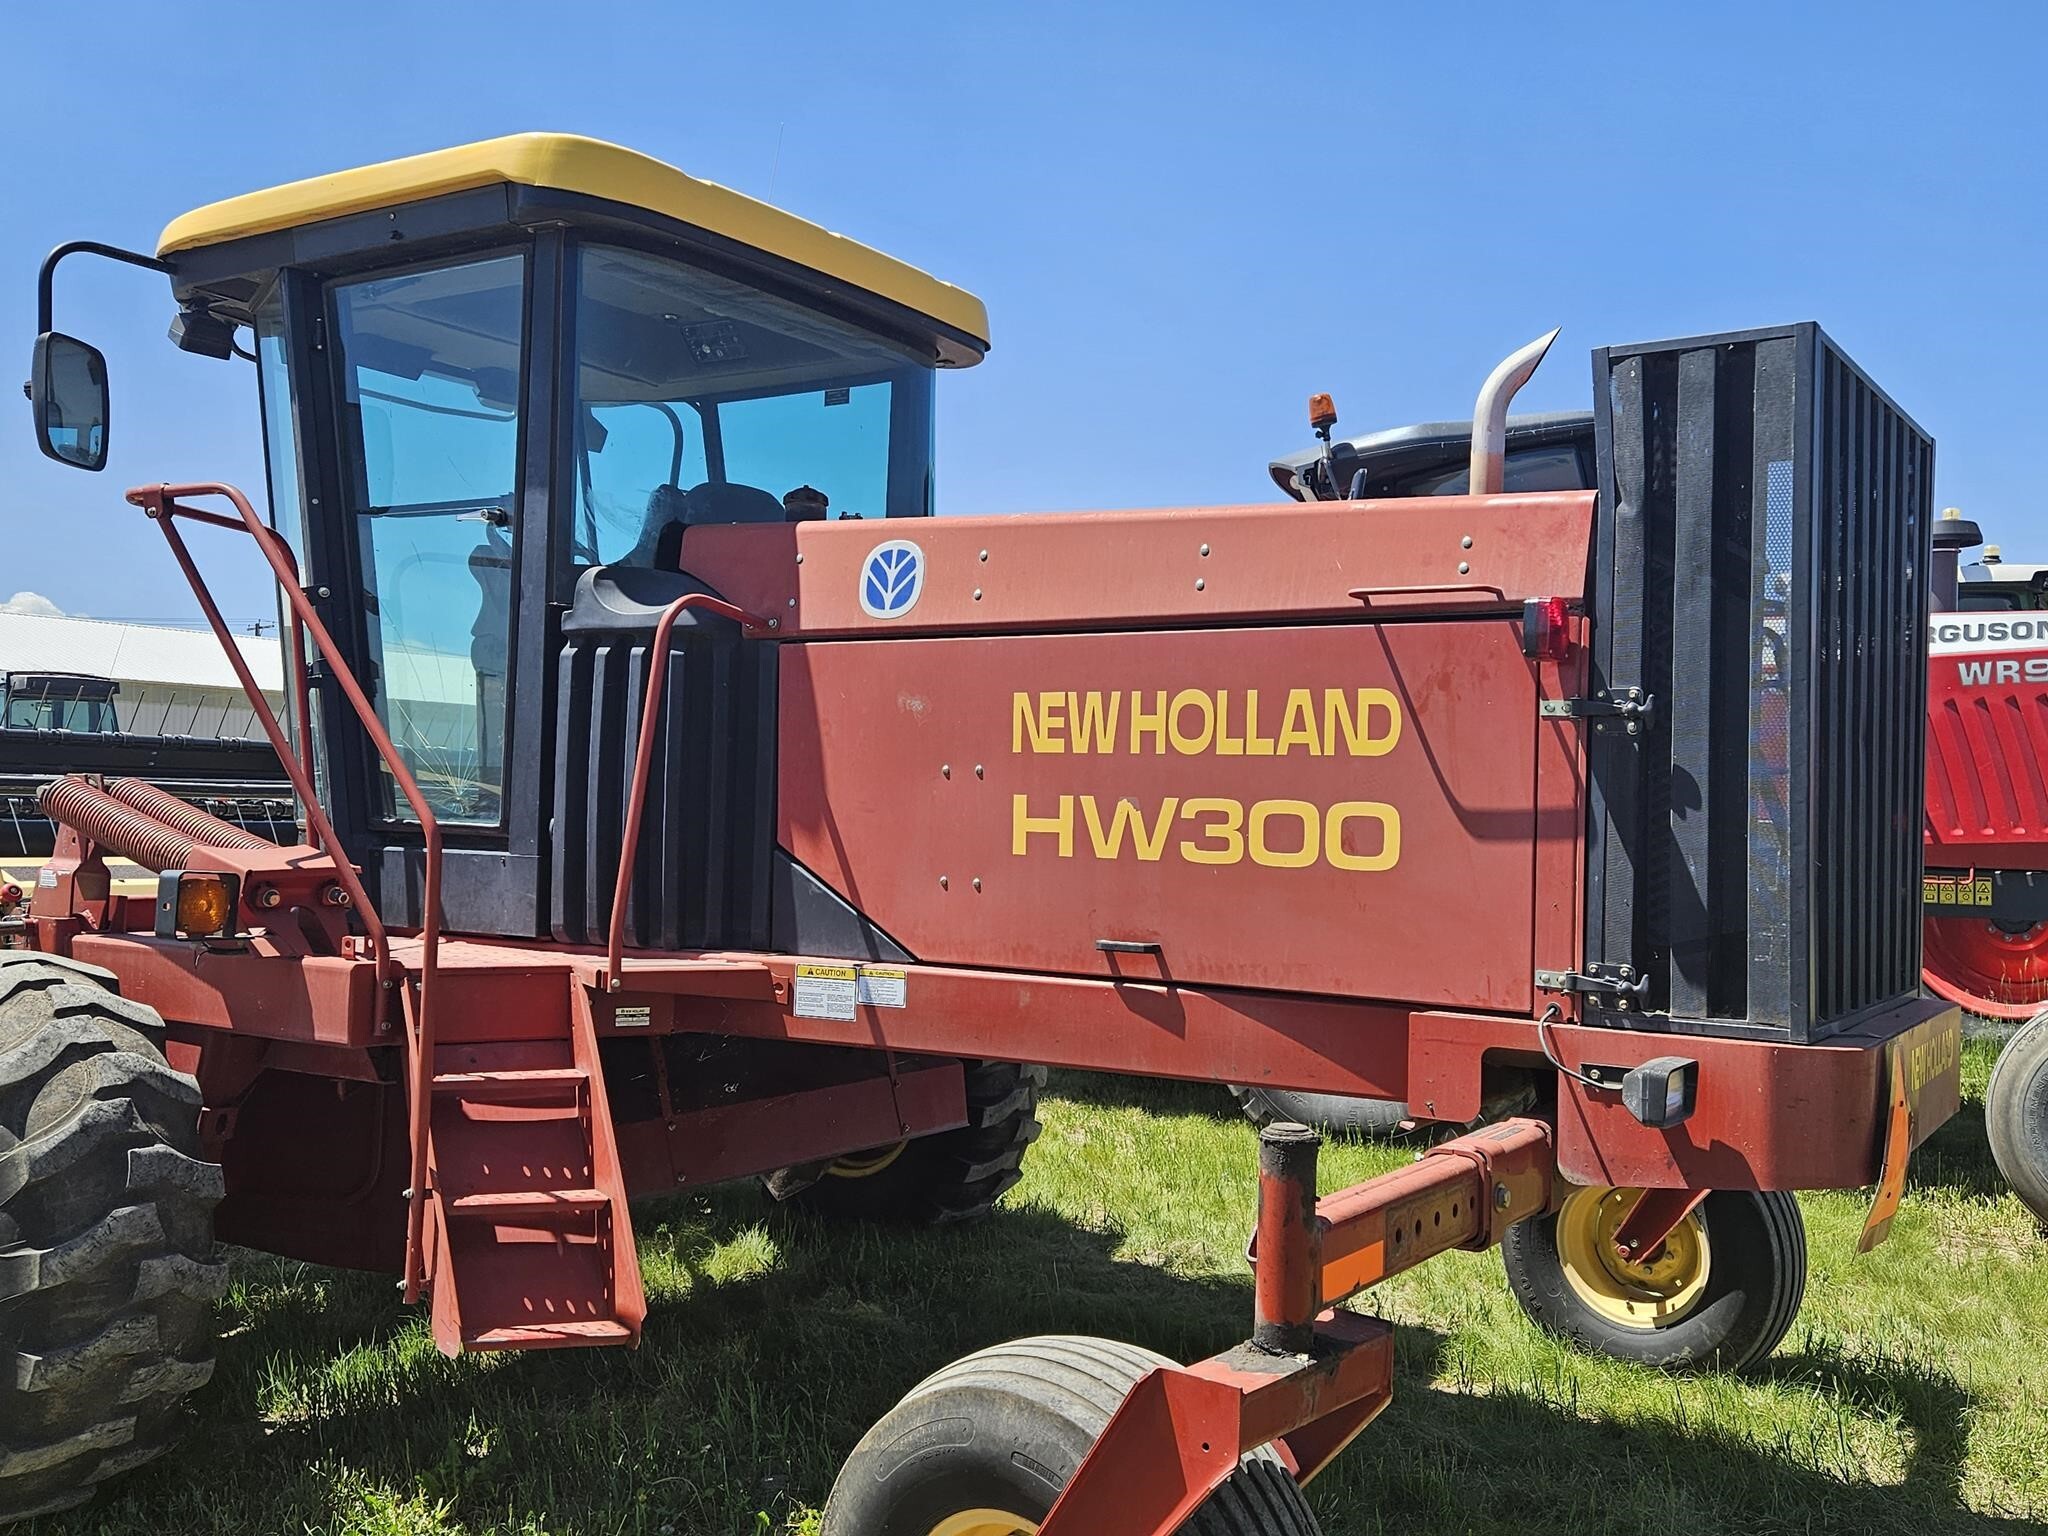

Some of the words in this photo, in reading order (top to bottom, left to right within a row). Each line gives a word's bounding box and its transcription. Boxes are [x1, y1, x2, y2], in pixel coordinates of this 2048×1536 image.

[1958, 658, 2048, 686] WR9
[1012, 691, 1121, 754] NEW
[1129, 688, 1402, 757] HOLLAND
[1012, 794, 1401, 872] HW300
[815, 967, 847, 977] CAUTION
